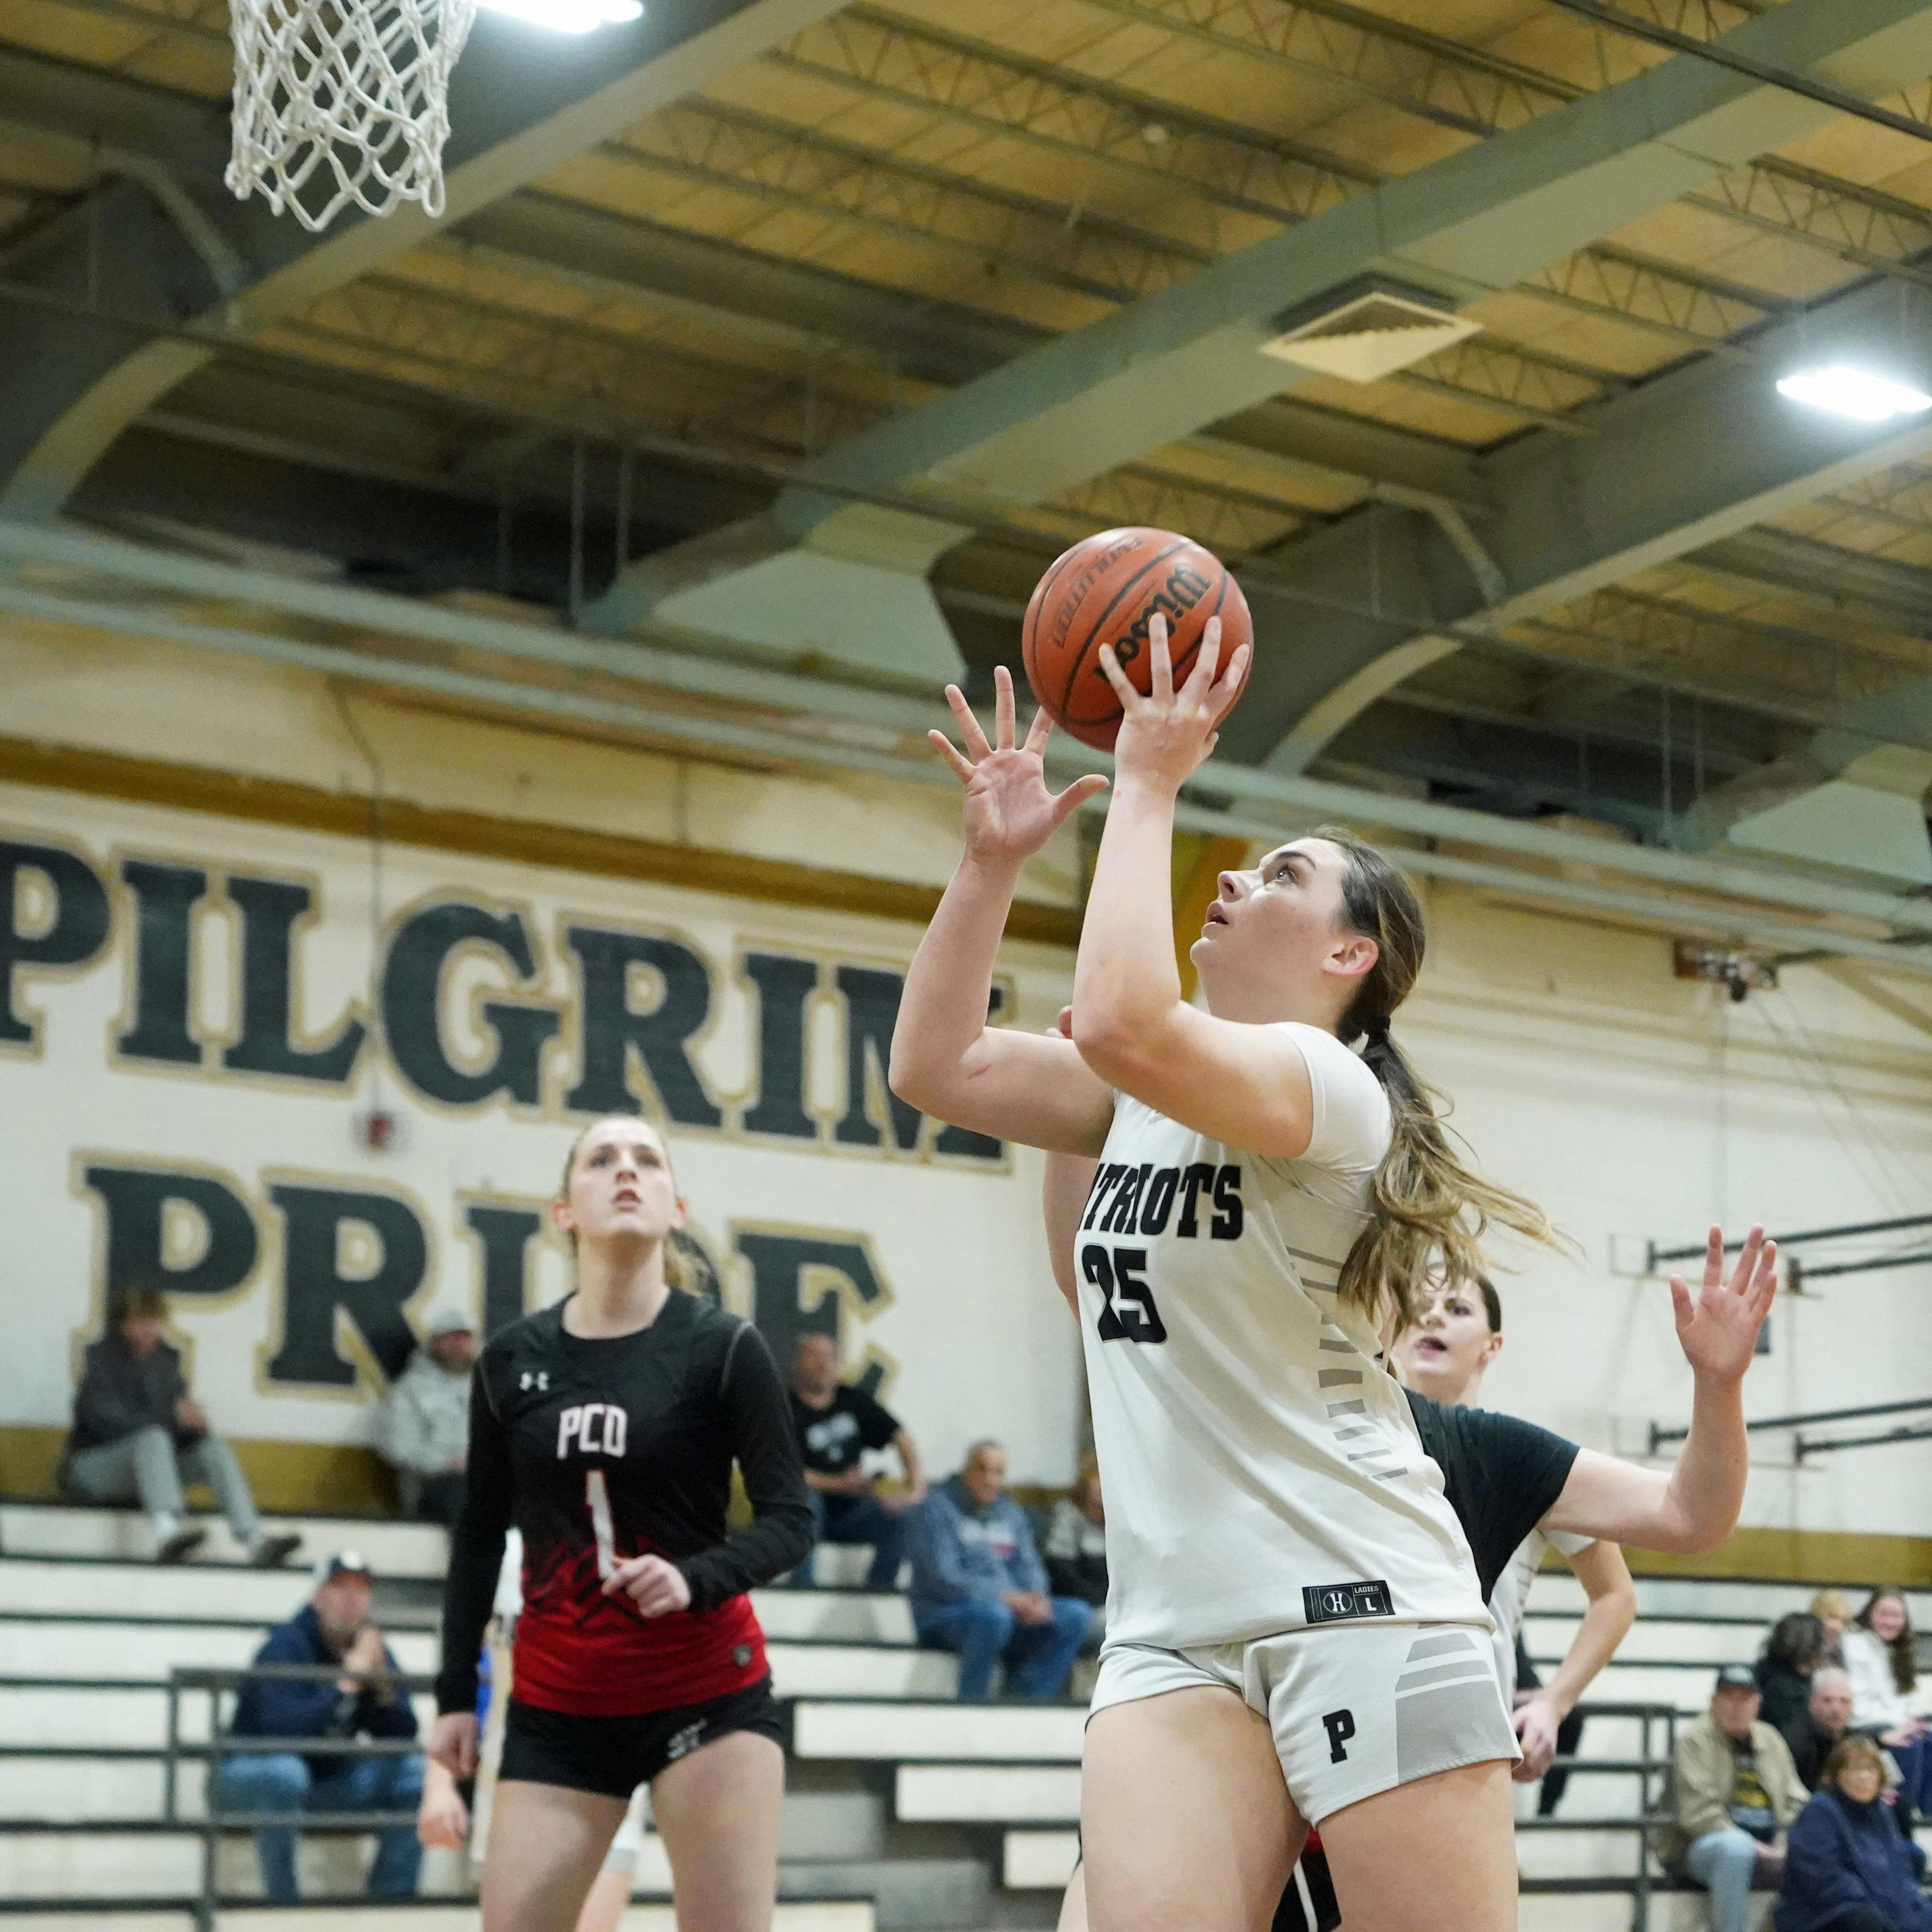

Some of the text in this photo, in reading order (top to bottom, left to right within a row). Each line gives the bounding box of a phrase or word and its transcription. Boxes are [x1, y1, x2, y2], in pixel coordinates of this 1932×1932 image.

[1078, 1162, 1244, 1240] TRIOTS
[83, 1164, 888, 1397] PRIE
[1081, 1242, 1168, 1344] 25
[557, 1403, 628, 1460] PCD
[584, 1469, 619, 1581] 1
[1354, 1585, 1379, 1594] LADIES
[1364, 1597, 1377, 1611] L
[1322, 1708, 1356, 1764] P
